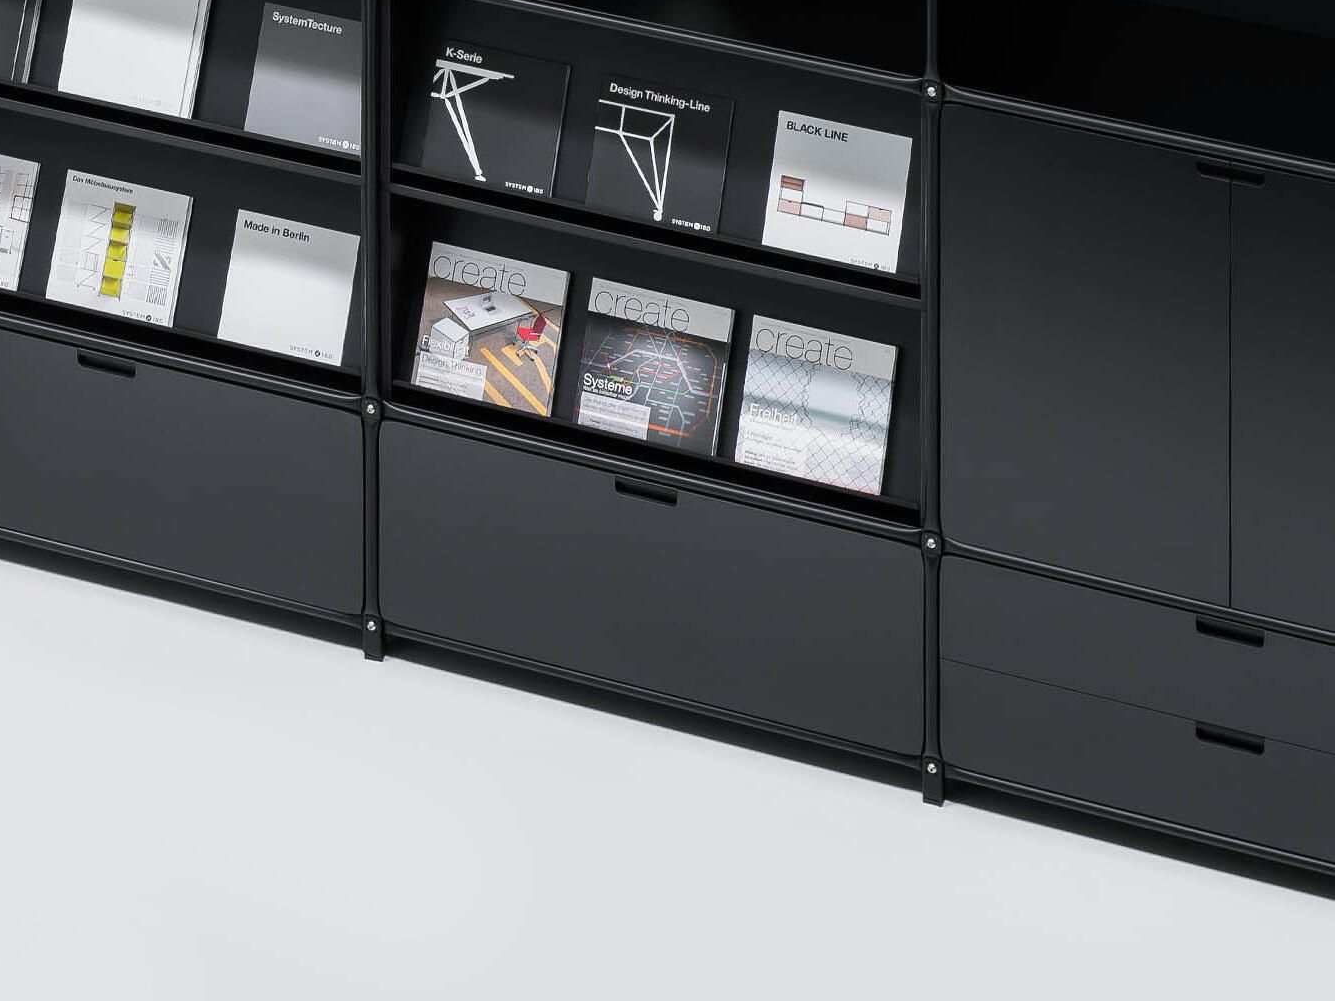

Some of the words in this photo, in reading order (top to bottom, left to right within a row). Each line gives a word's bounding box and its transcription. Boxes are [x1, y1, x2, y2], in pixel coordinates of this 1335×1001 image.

[272, 11, 343, 35] SystemTecture
[445, 47, 483, 64] K-Serie
[609, 82, 644, 99] Design
[644, 89, 711, 113] Thinking-Line
[786, 120, 823, 137] BLACK
[824, 128, 849, 143] LINE
[243, 219, 270, 234] Made
[271, 224, 281, 236] in
[282, 227, 311, 243] Berlin
[433, 255, 527, 296] create
[594, 290, 690, 333] create
[755, 328, 853, 371] create
[582, 372, 634, 396] Systeme
